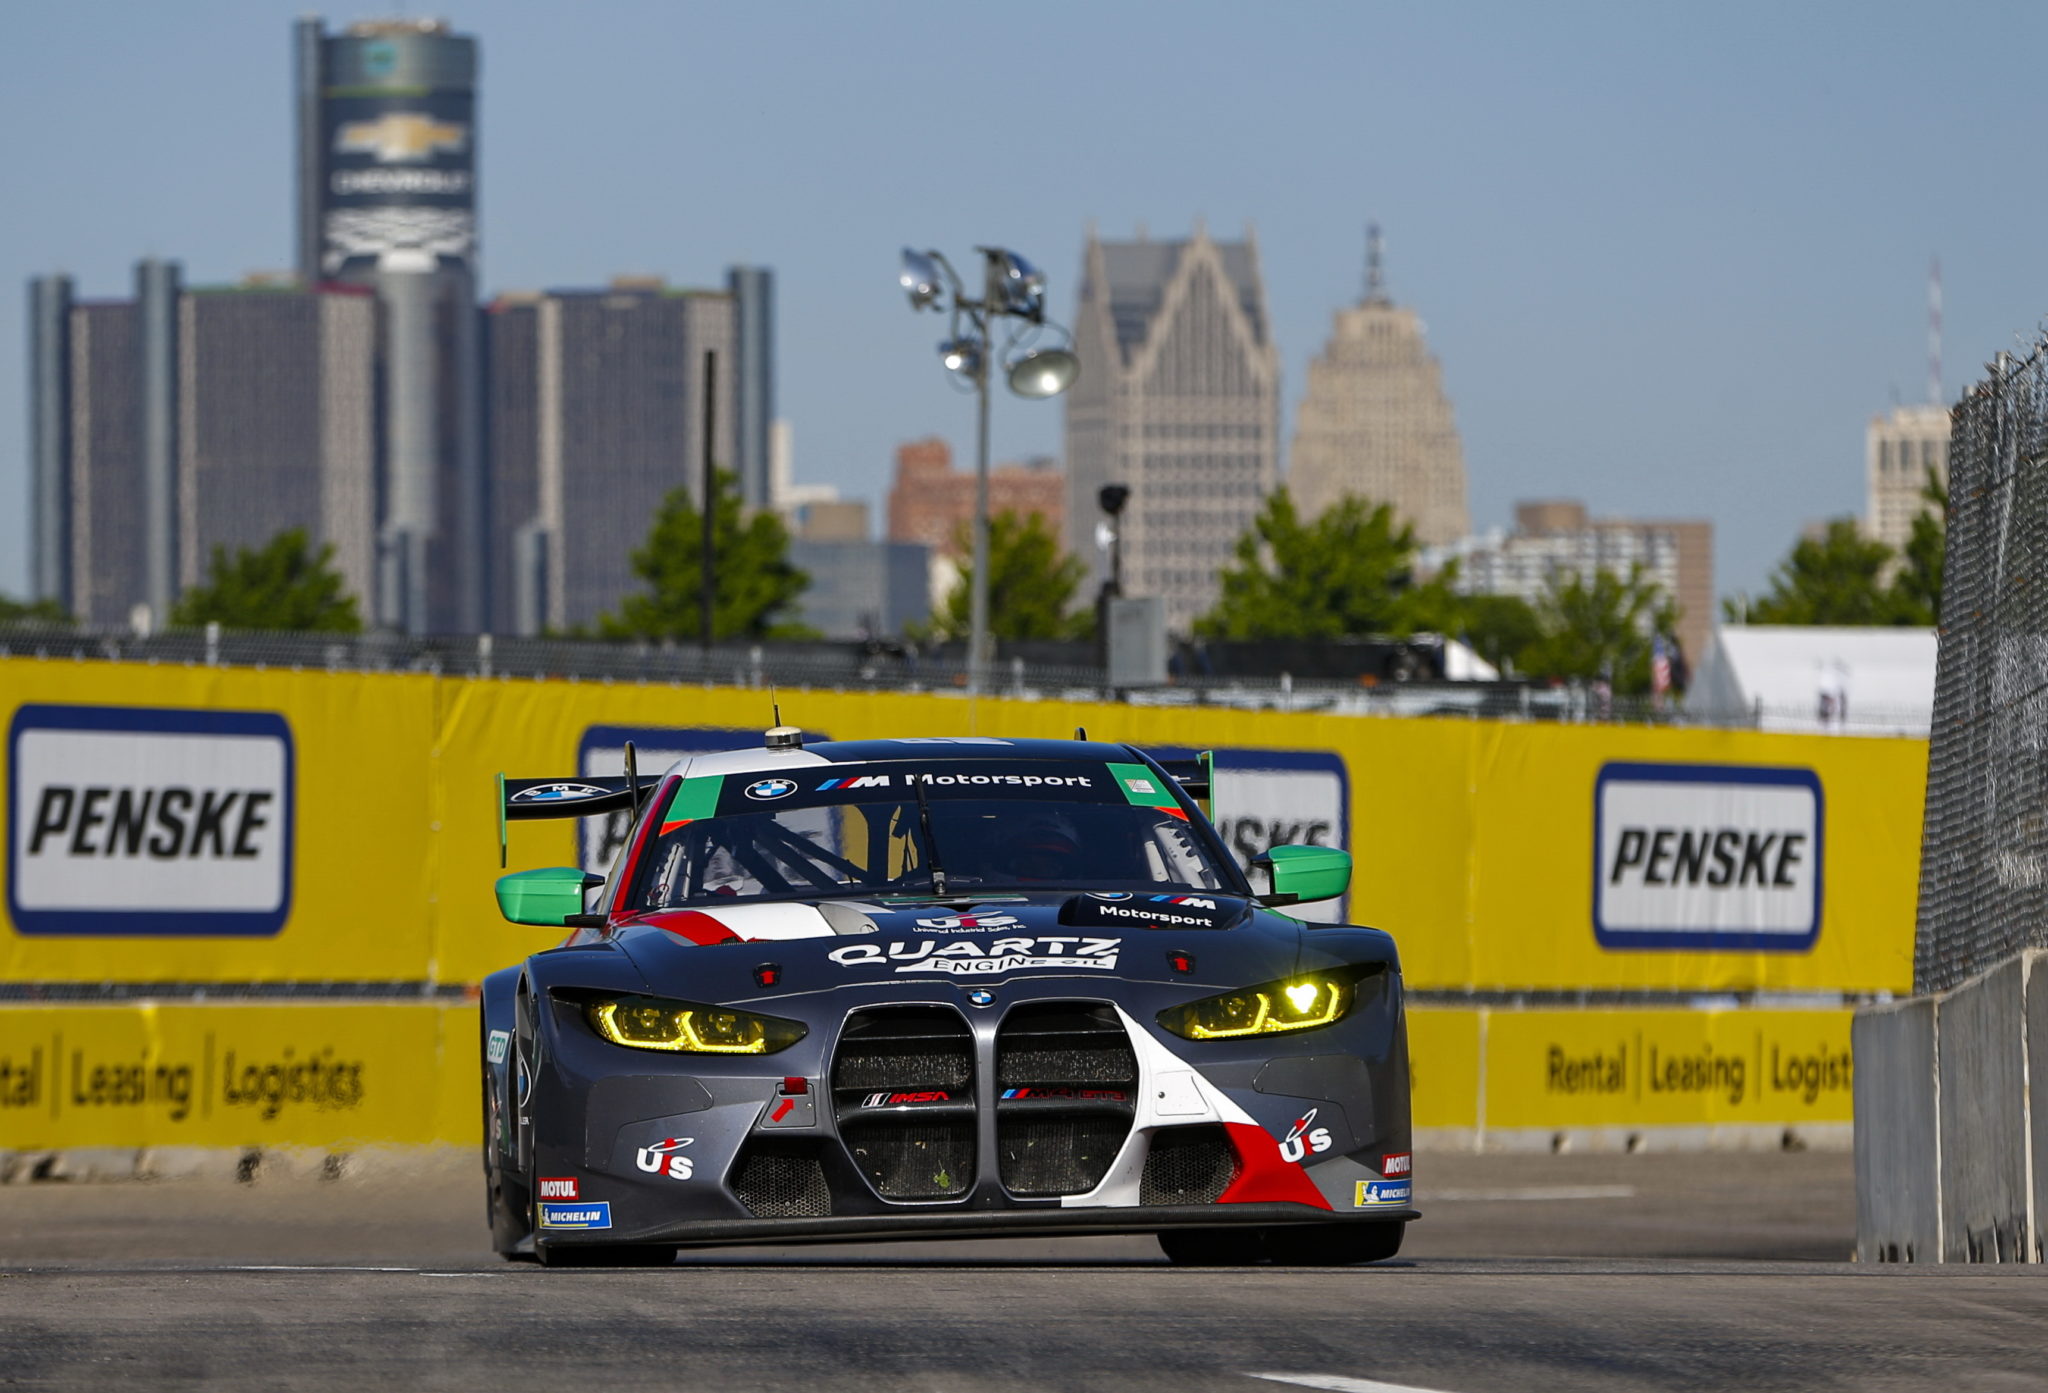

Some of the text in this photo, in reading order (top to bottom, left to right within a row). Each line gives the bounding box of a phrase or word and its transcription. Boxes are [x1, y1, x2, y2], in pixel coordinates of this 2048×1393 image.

[905, 774, 1092, 788] Motorsport
[28, 787, 273, 860] PENSKE
[1610, 828, 1806, 888] PENSKE
[1099, 905, 1212, 927] Motorsport
[828, 937, 1122, 966] QUARTZ
[933, 957, 1047, 972] ENGINE
[489, 1035, 506, 1057] GTD
[72, 1047, 193, 1121] Leasing
[223, 1046, 364, 1120] Logistics
[1547, 1041, 1850, 1105] Rental Leasing Logist
[889, 1091, 950, 1103] IMSA
[541, 1181, 576, 1197] MOTUL
[550, 1211, 601, 1222] MICHELIN
